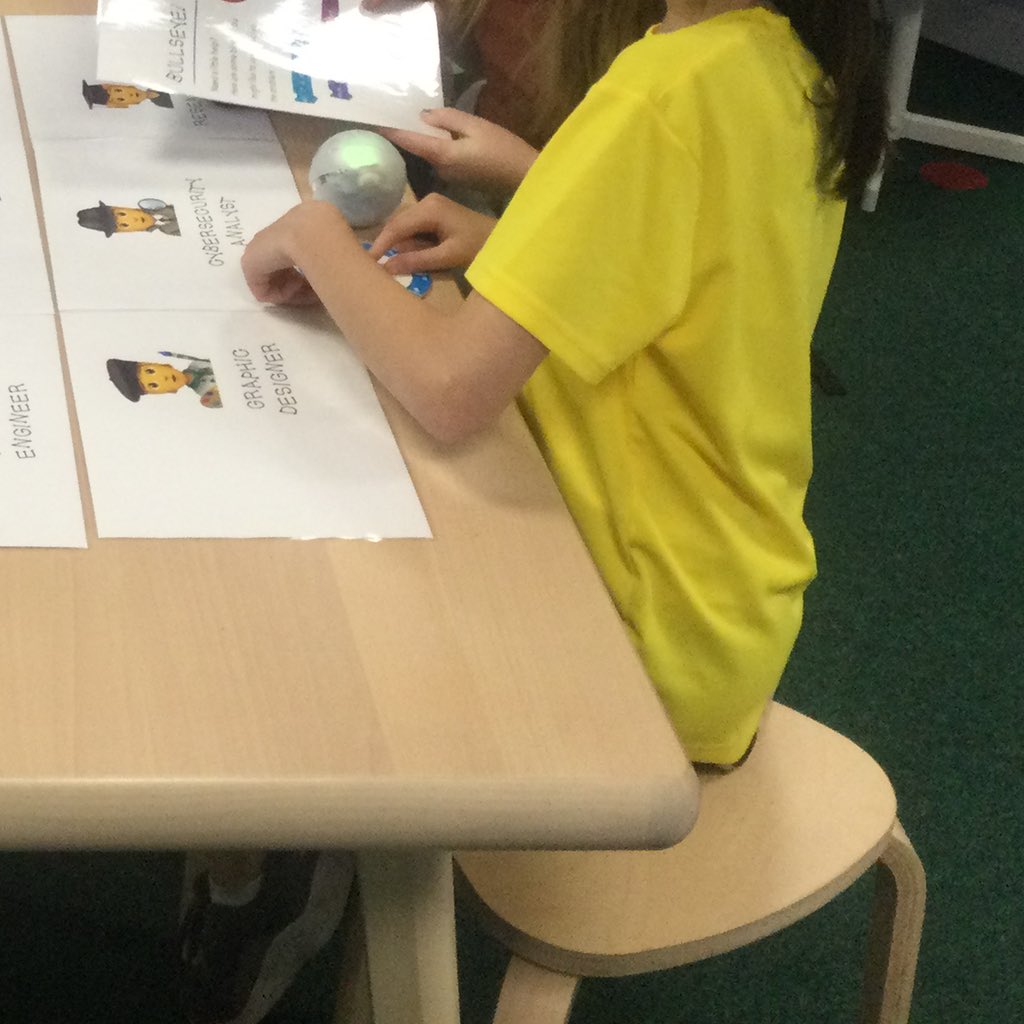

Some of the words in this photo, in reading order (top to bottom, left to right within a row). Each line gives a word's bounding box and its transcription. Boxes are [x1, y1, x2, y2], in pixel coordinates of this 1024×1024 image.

[185, 177, 225, 267] CYBERSECURITY
[232, 348, 265, 410] GRAPHIC
[260, 343, 297, 415] DESIGNER
[7, 382, 36, 459] ENGINEER
